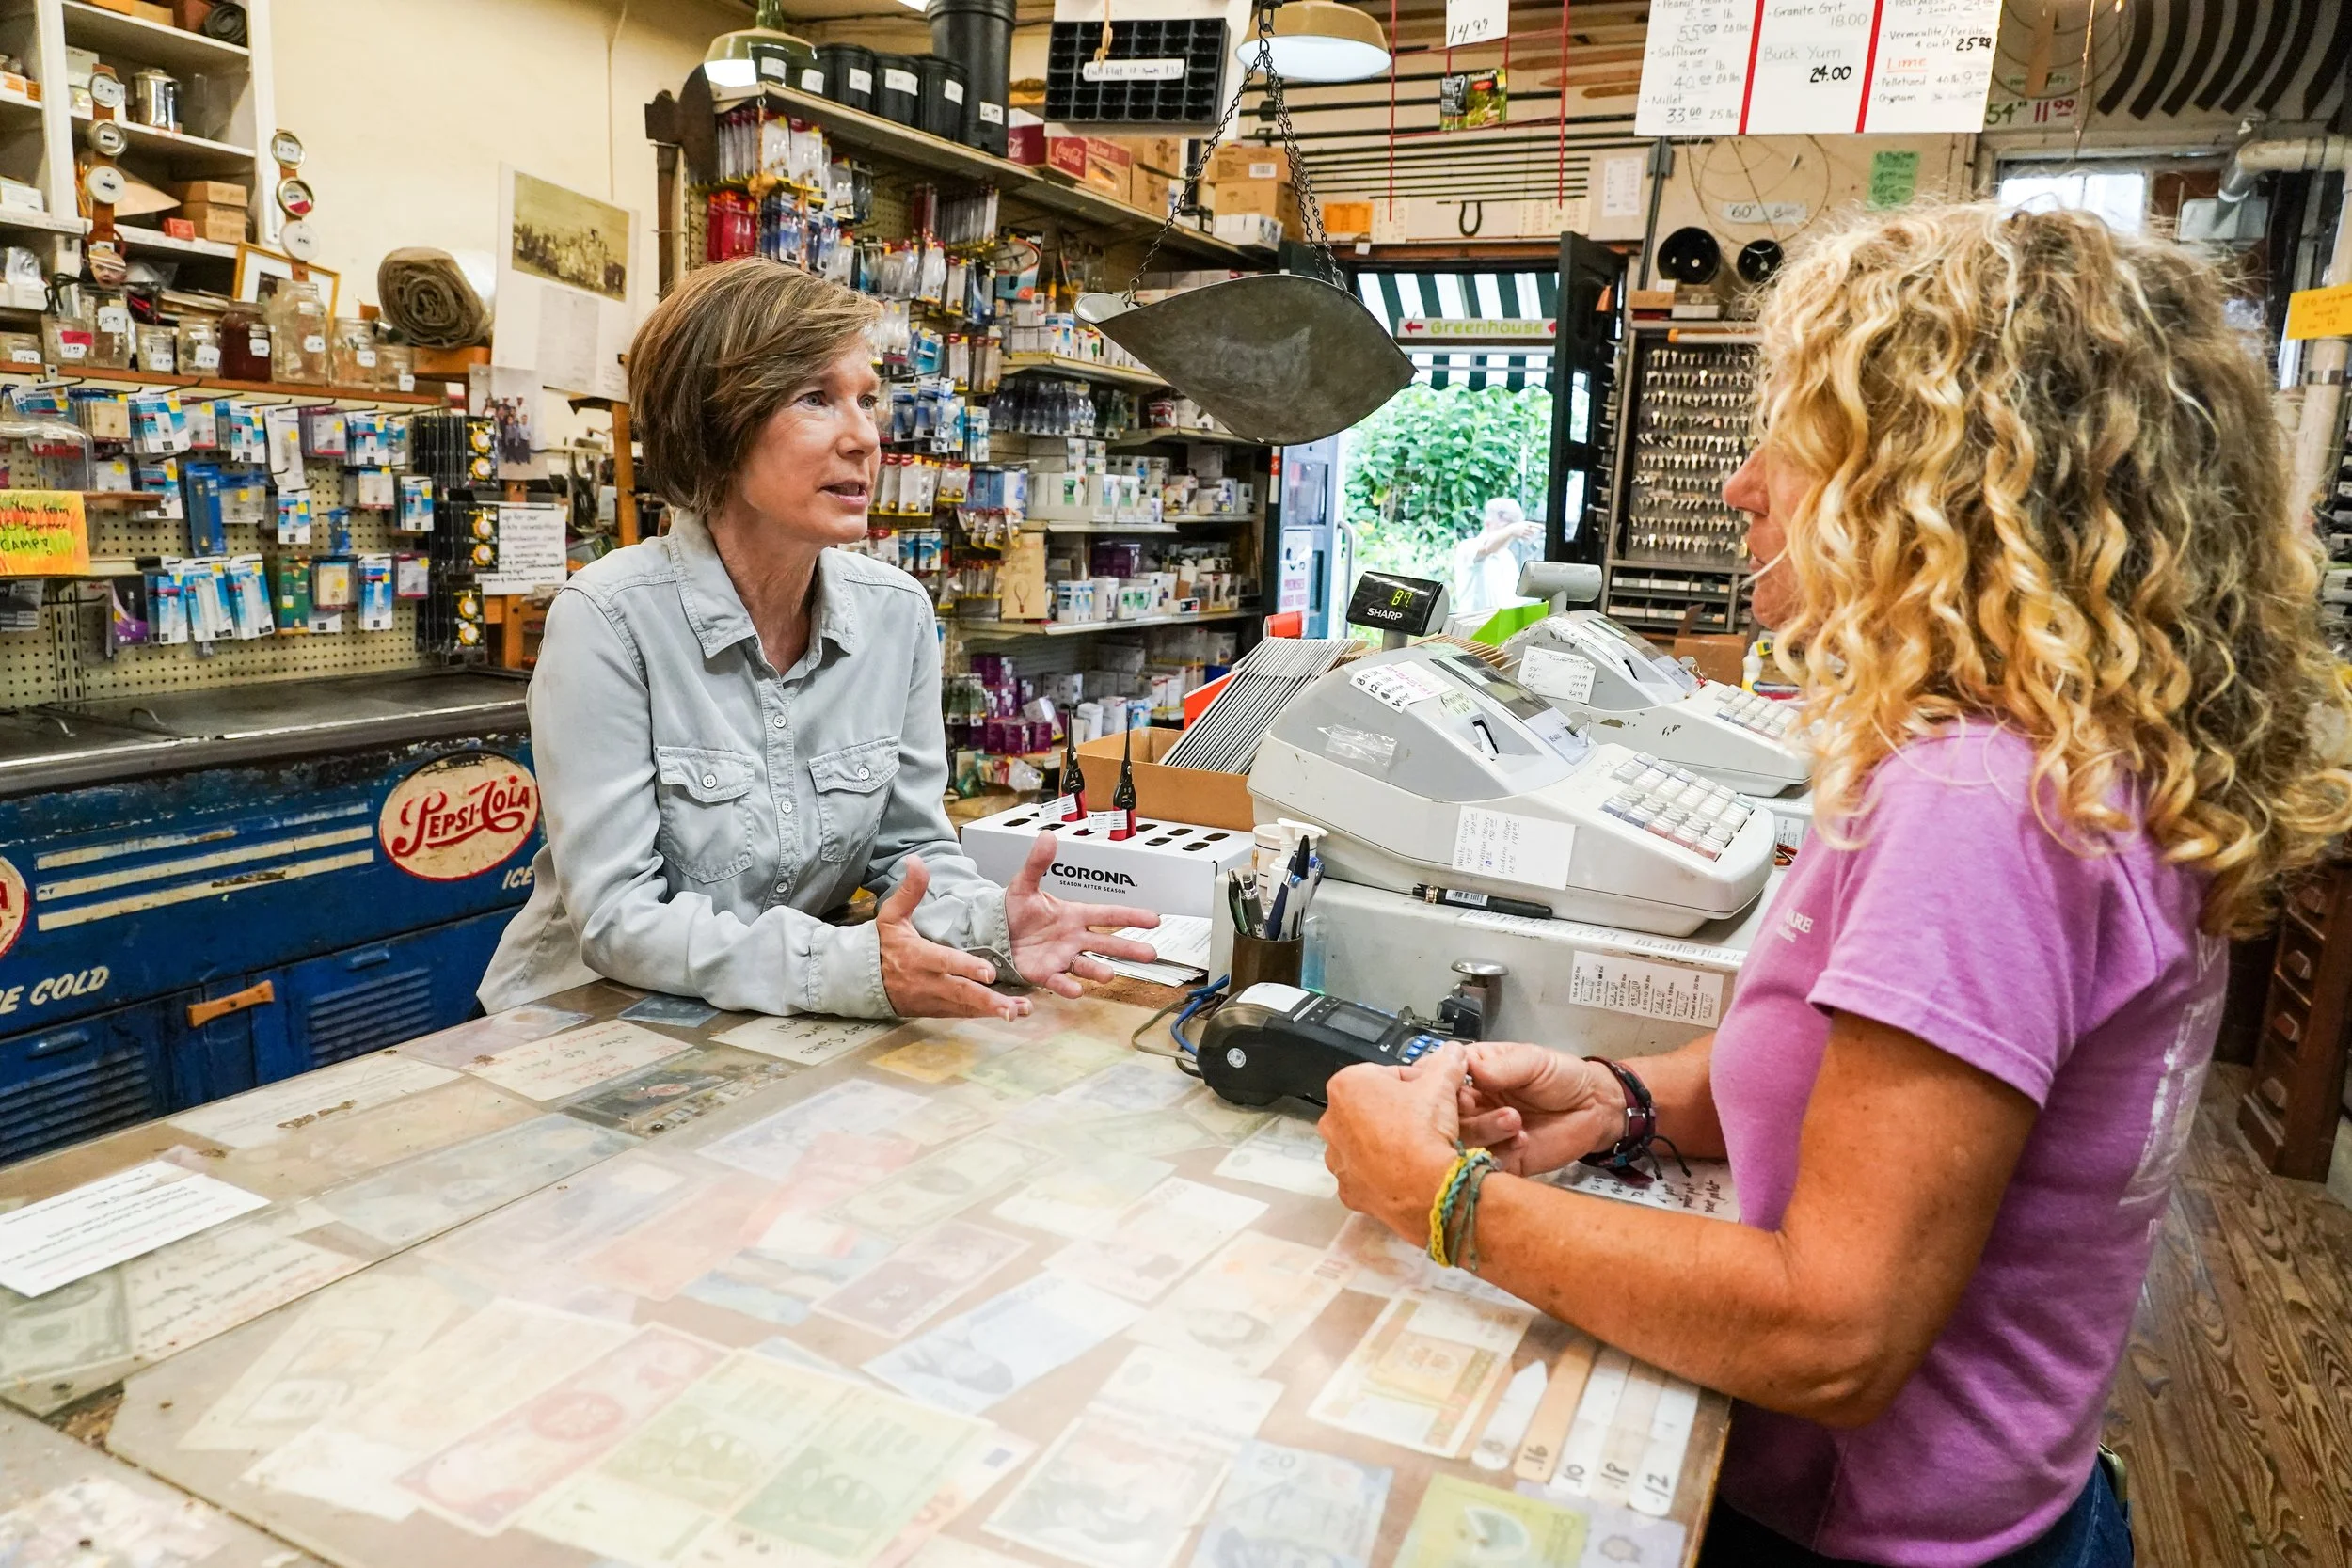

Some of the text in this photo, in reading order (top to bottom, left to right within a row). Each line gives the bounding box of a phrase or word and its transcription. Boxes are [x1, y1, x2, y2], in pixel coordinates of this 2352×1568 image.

[1810, 65, 1851, 83] 24.00
[1430, 320, 1543, 336] Greenhouse
[1367, 607, 1403, 621] SHARP
[502, 866, 535, 890] ICE
[1051, 863, 1136, 887] CORONA
[1059, 879, 1081, 888] SEASON
[1104, 886, 1126, 895] SEASON
[29, 966, 110, 1006] COLD
